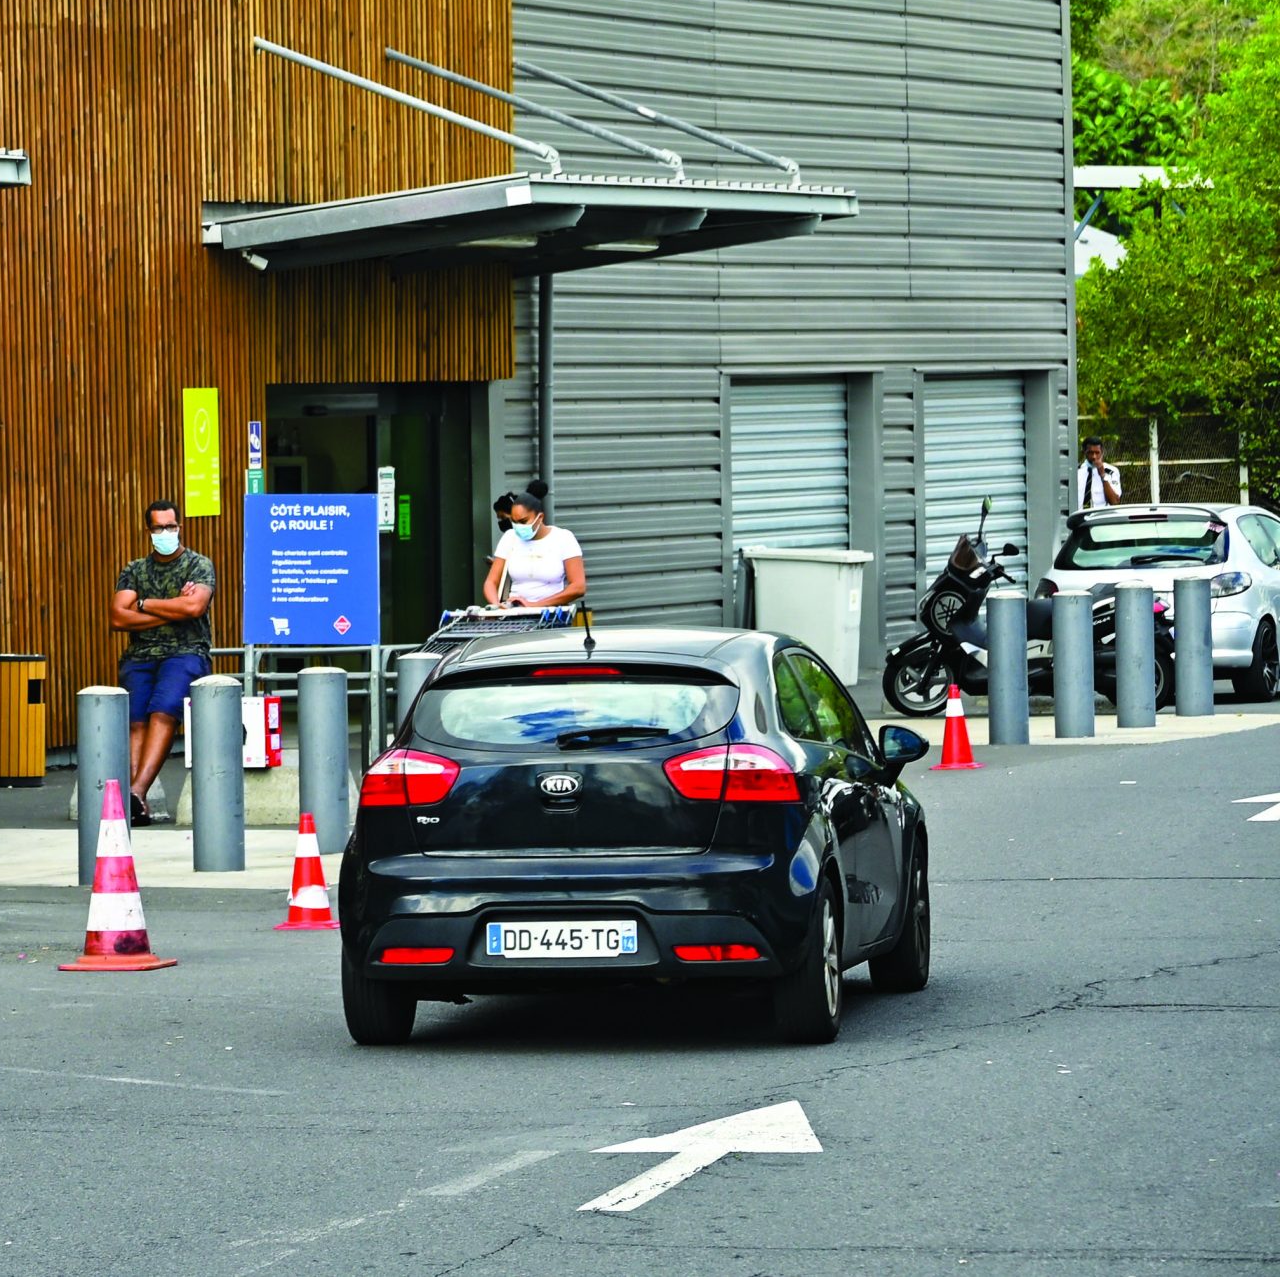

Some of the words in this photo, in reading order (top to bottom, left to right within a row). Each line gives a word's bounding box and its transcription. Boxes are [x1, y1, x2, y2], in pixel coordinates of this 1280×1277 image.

[270, 503, 302, 517] CÔTÉ
[303, 504, 351, 518] PLAISIR,
[270, 519, 287, 533] ÇA
[288, 519, 328, 531] ROULE
[329, 519, 334, 531] !
[546, 779, 573, 792] KIA
[504, 928, 620, 951] DD-445-TG
